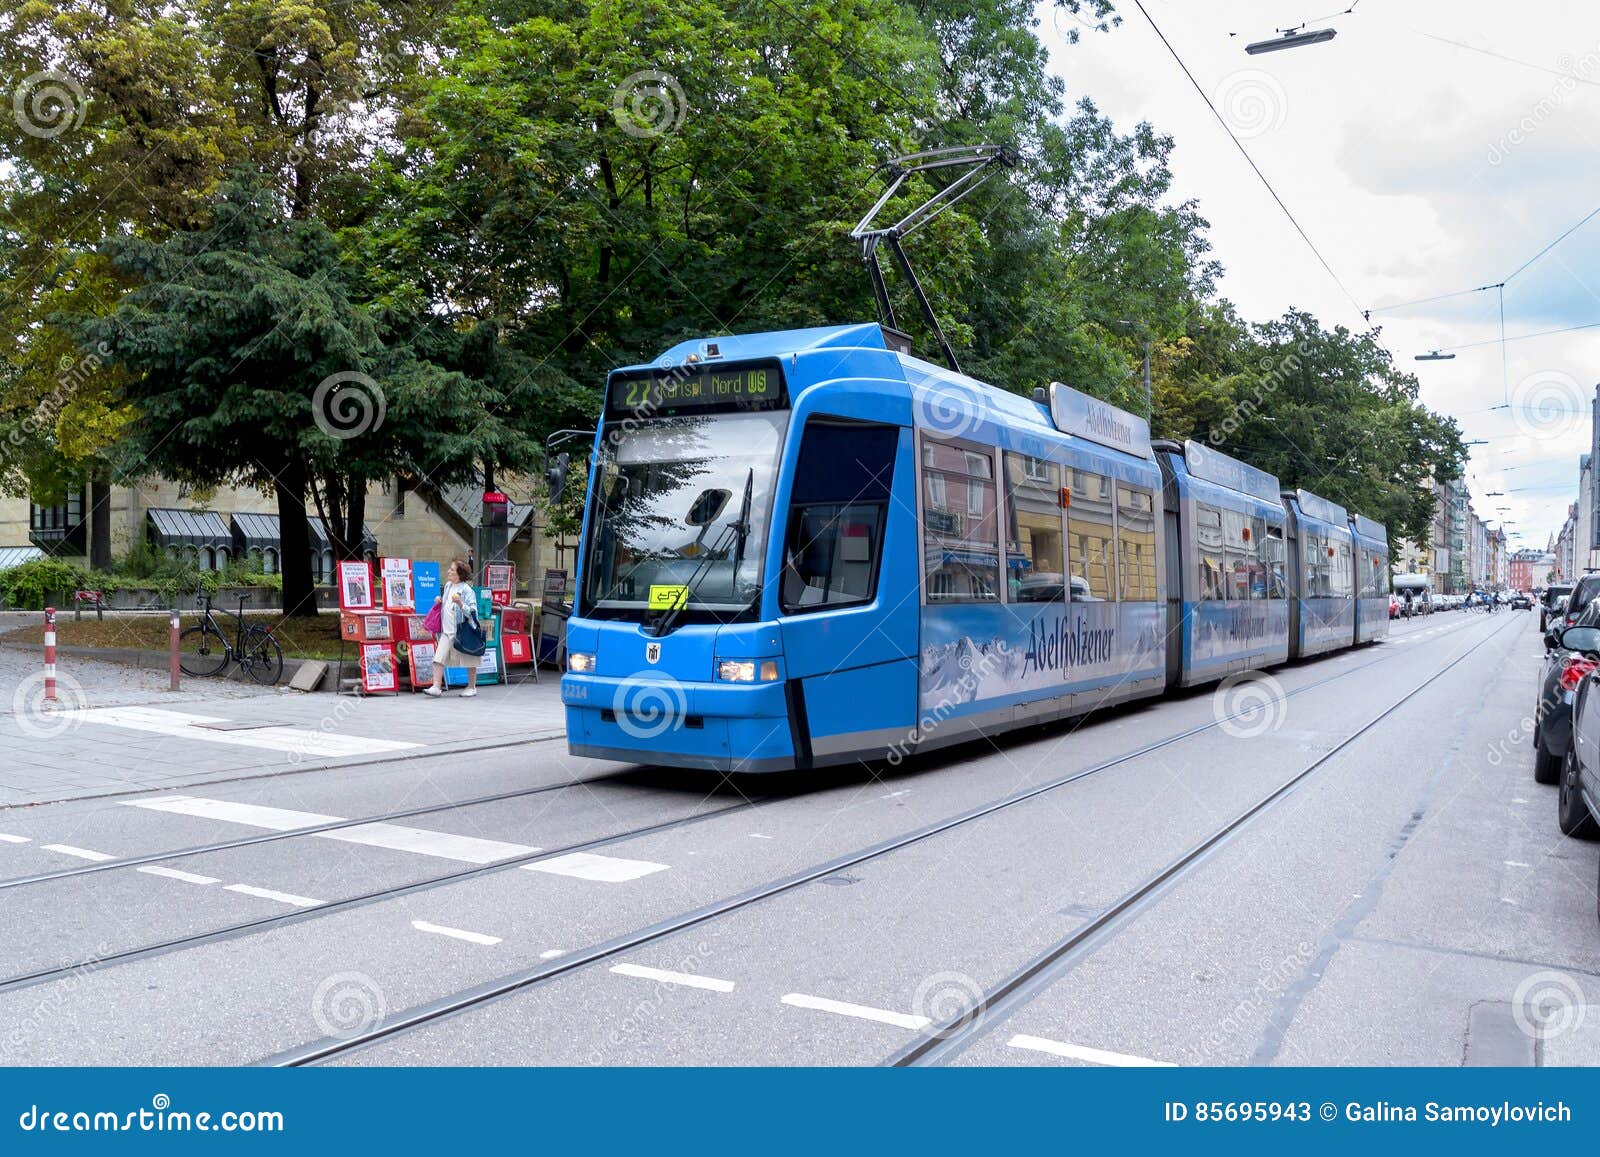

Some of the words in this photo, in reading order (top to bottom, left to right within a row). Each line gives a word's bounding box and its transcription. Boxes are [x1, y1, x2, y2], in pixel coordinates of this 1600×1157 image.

[624, 380, 650, 406] 27
[711, 374, 742, 394] Nord
[1021, 616, 1114, 680] Adelholzener
[564, 683, 588, 699] 2214
